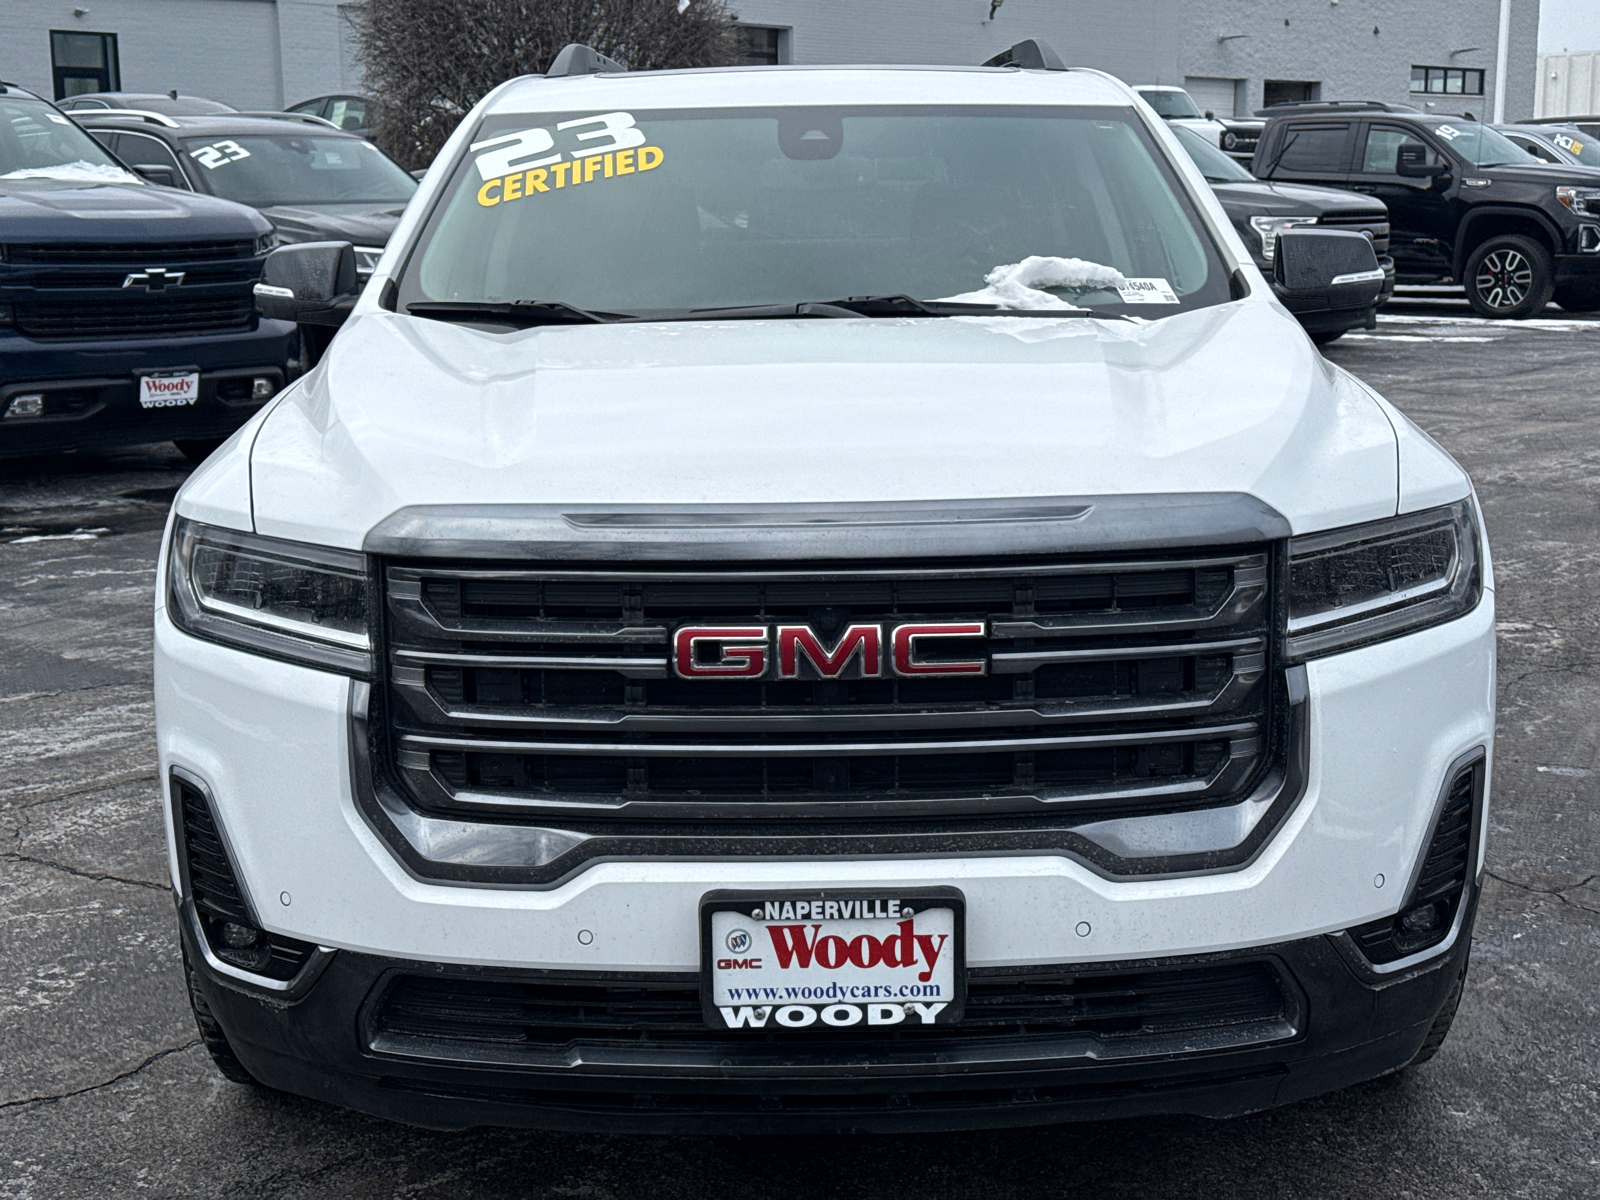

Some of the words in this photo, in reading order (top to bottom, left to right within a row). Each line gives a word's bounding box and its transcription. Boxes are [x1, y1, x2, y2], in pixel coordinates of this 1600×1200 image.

[189, 139, 251, 170] 23
[469, 111, 647, 182] 23
[477, 145, 665, 208] CERTIFIED
[144, 378, 194, 394] Woody
[141, 398, 197, 409] WOODY
[673, 621, 988, 680] GMC
[764, 899, 901, 920] NAPERVILLE
[765, 918, 949, 982] Woody
[717, 958, 763, 970] GMC
[727, 982, 942, 1003] www.woodycars.com
[719, 1002, 949, 1029] WOODY
